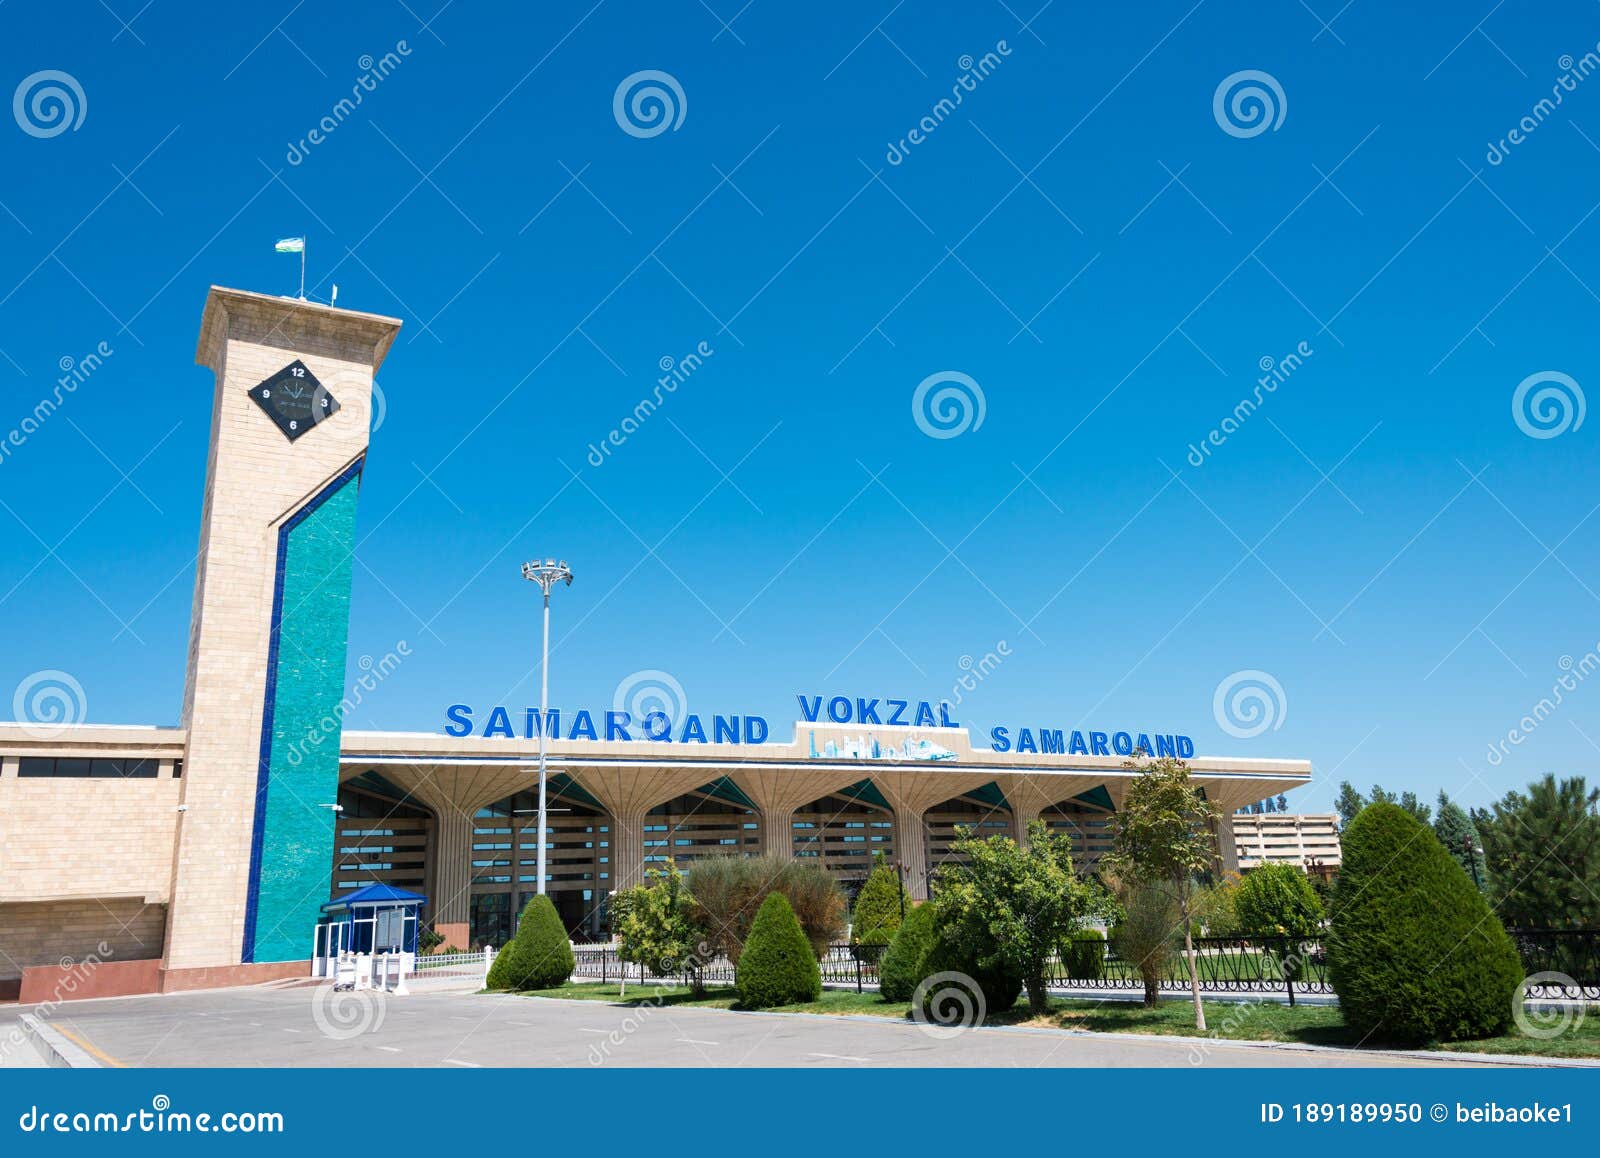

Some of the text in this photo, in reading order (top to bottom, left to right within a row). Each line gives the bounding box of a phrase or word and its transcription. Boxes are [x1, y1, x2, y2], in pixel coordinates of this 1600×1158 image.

[291, 367, 304, 377] 12
[262, 389, 271, 399] 9
[320, 398, 329, 408] 3
[289, 420, 298, 430] 6
[797, 695, 960, 728] VOKZAL
[444, 704, 770, 745] SAMARQAND
[991, 726, 1195, 759] SAMARQAND
